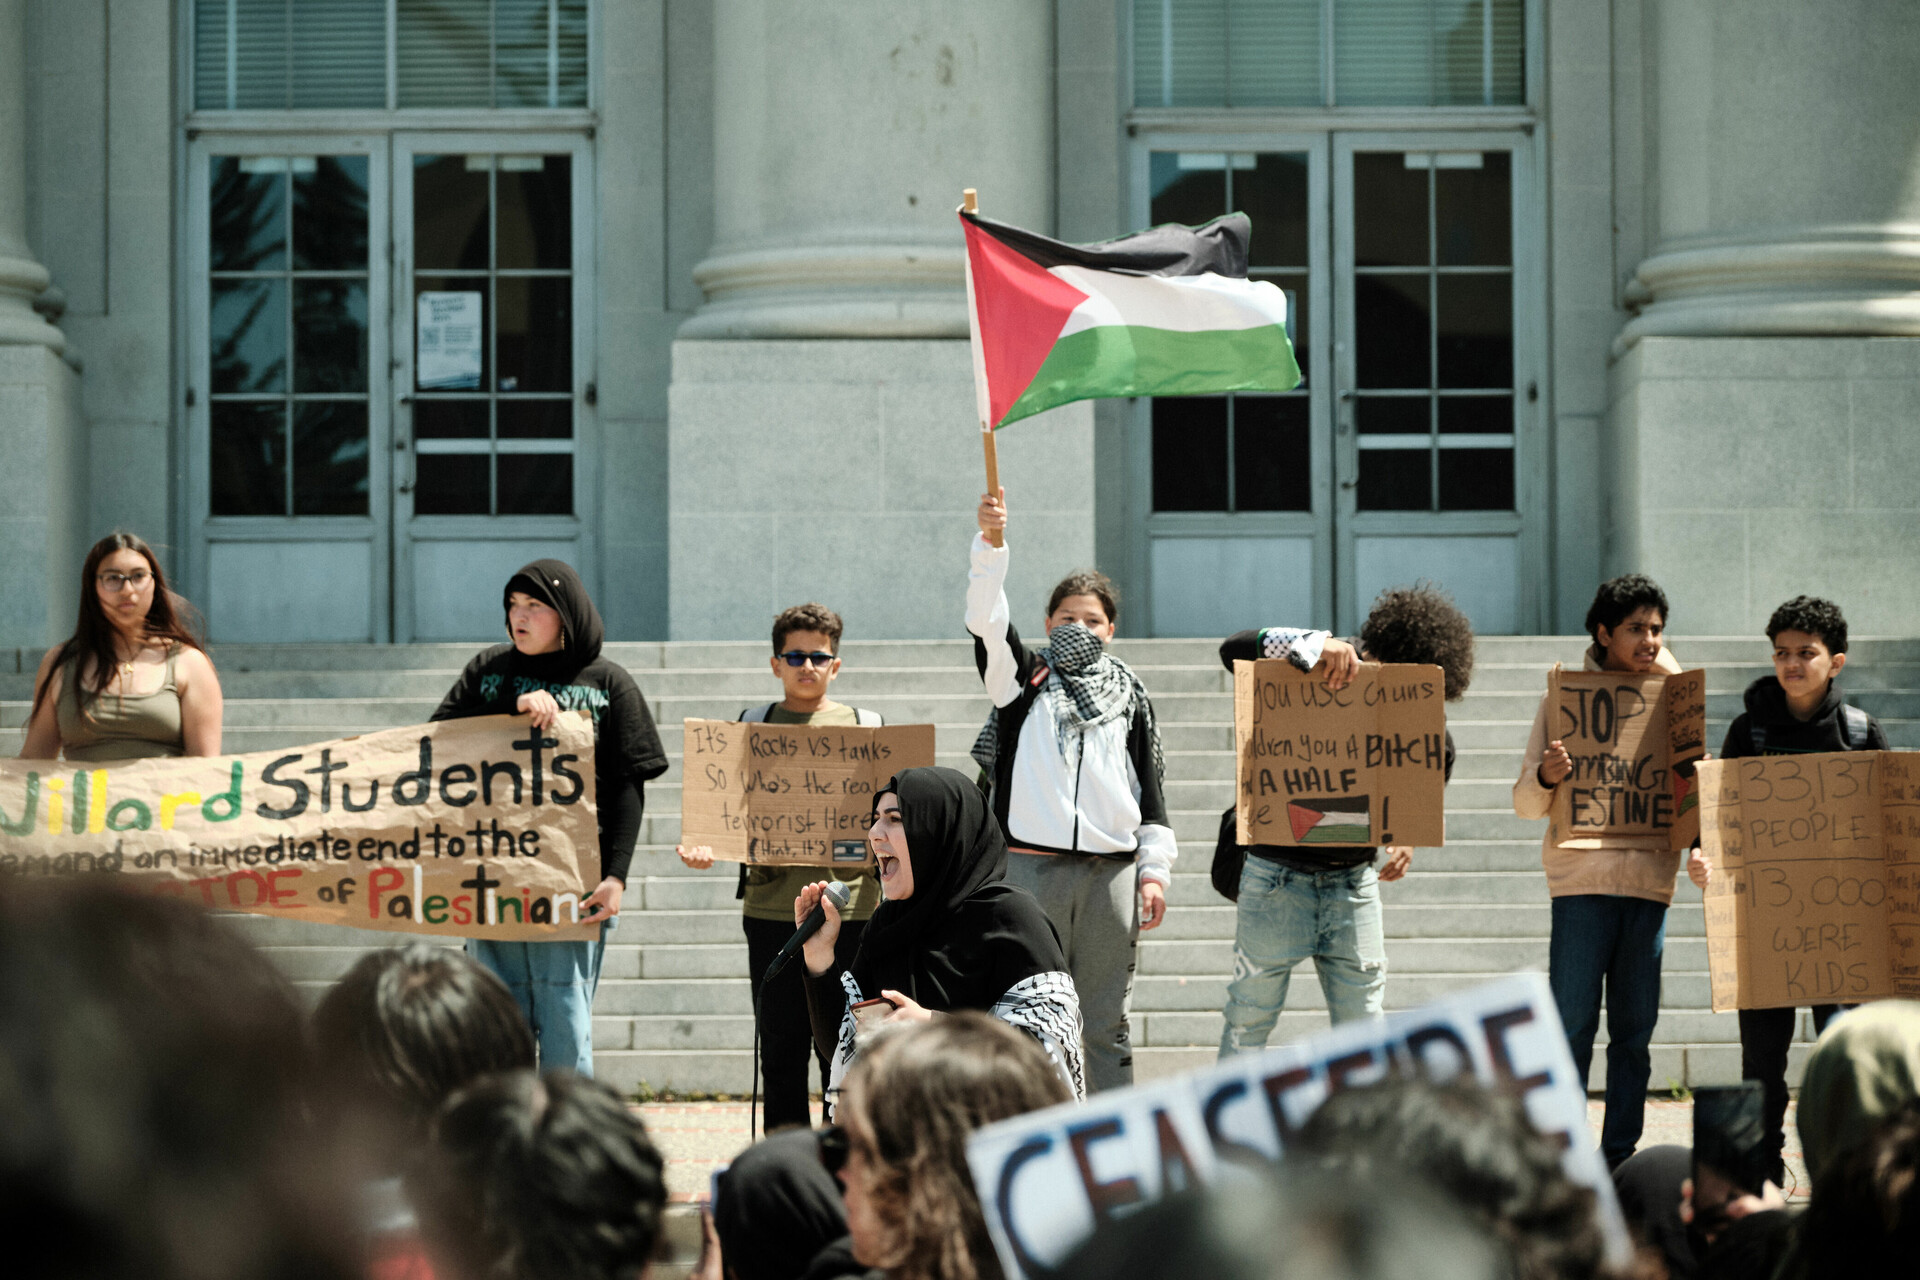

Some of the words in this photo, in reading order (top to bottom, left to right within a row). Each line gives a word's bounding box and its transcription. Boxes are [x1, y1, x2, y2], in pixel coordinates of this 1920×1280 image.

[839, 735, 892, 762] tanks
[256, 726, 585, 820] Students
[803, 770, 835, 794] the
[843, 776, 879, 794] real
[1283, 765, 1357, 796] HALF
[721, 802, 816, 834] terrorist
[1571, 786, 1674, 828] ESTINE
[0, 838, 123, 873] emand
[134, 848, 178, 869] an
[189, 829, 352, 866] immediate
[357, 826, 420, 861] end
[426, 824, 466, 857] to
[466, 818, 541, 858] the
[1750, 811, 1870, 849] PEOPLE
[318, 877, 356, 904] of
[1750, 867, 1887, 917] 13,000
[1772, 923, 1862, 953] WERE
[1785, 961, 1869, 998] KIDS
